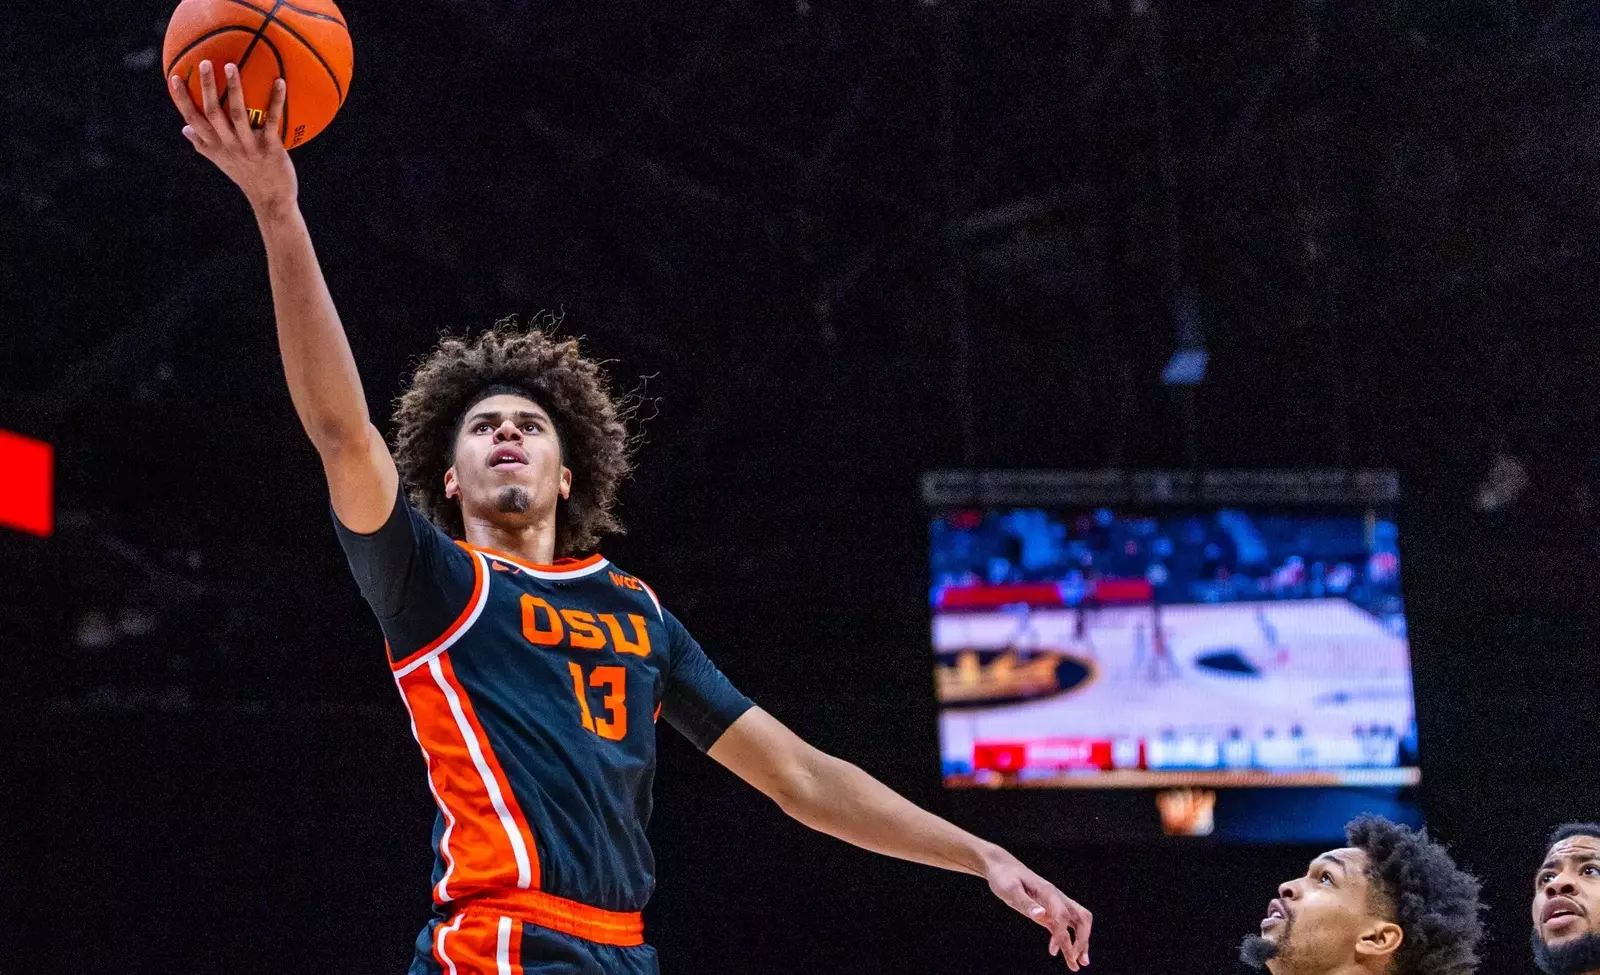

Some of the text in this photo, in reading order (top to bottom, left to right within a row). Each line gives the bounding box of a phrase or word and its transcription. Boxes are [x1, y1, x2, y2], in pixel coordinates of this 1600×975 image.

[608, 570, 643, 591] WCC
[519, 593, 652, 657] OSU
[568, 661, 628, 741] 13
